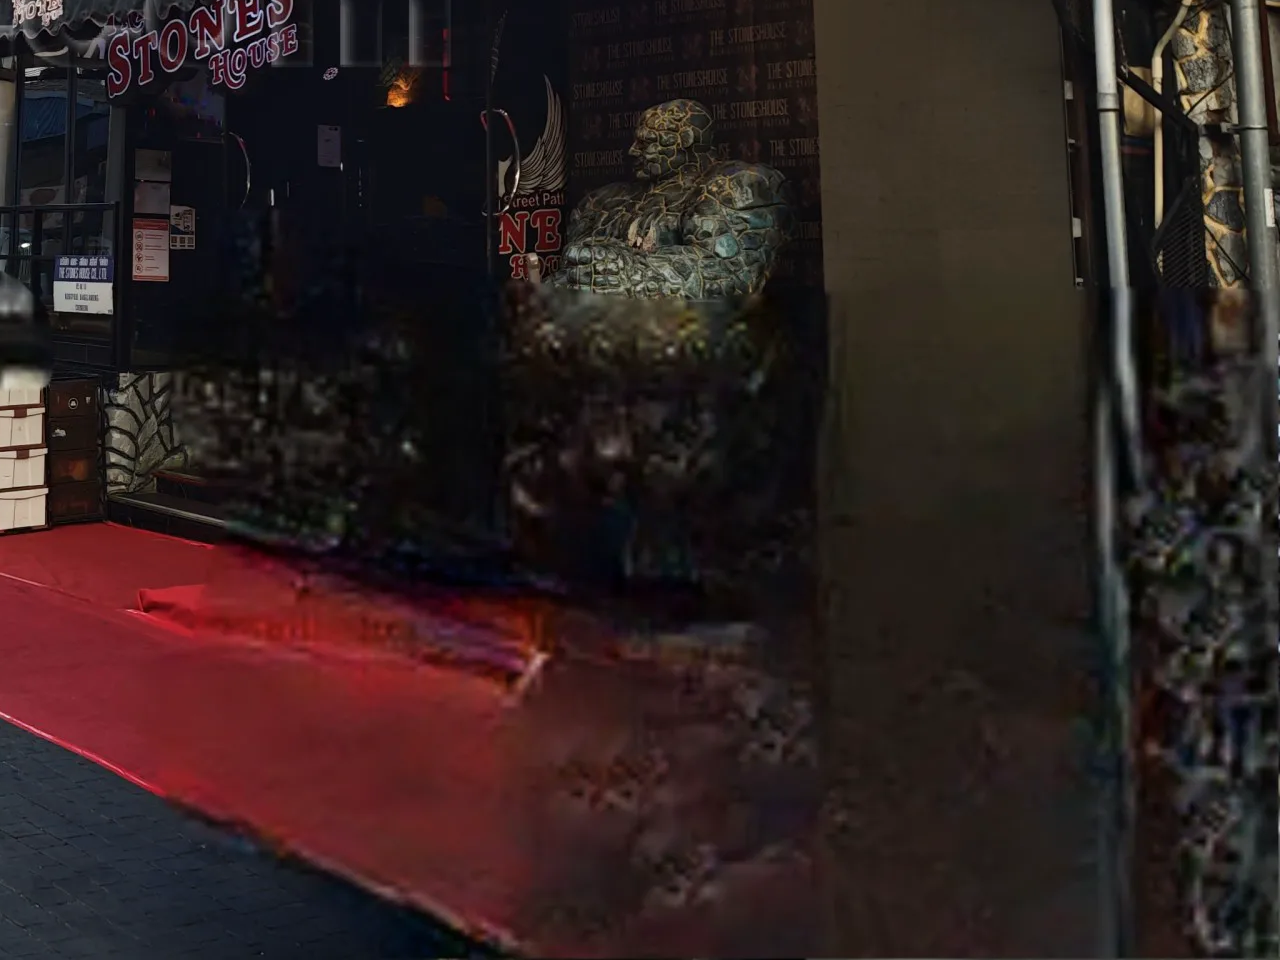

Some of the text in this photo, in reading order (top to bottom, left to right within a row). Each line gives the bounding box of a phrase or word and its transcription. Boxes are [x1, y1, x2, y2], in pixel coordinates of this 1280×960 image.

[728, 21, 786, 44] STONESHOUSE
[209, 24, 299, 89] HOUSE
[673, 68, 729, 89] STONESHOUSE
[730, 98, 790, 119] STONESHOUSE
